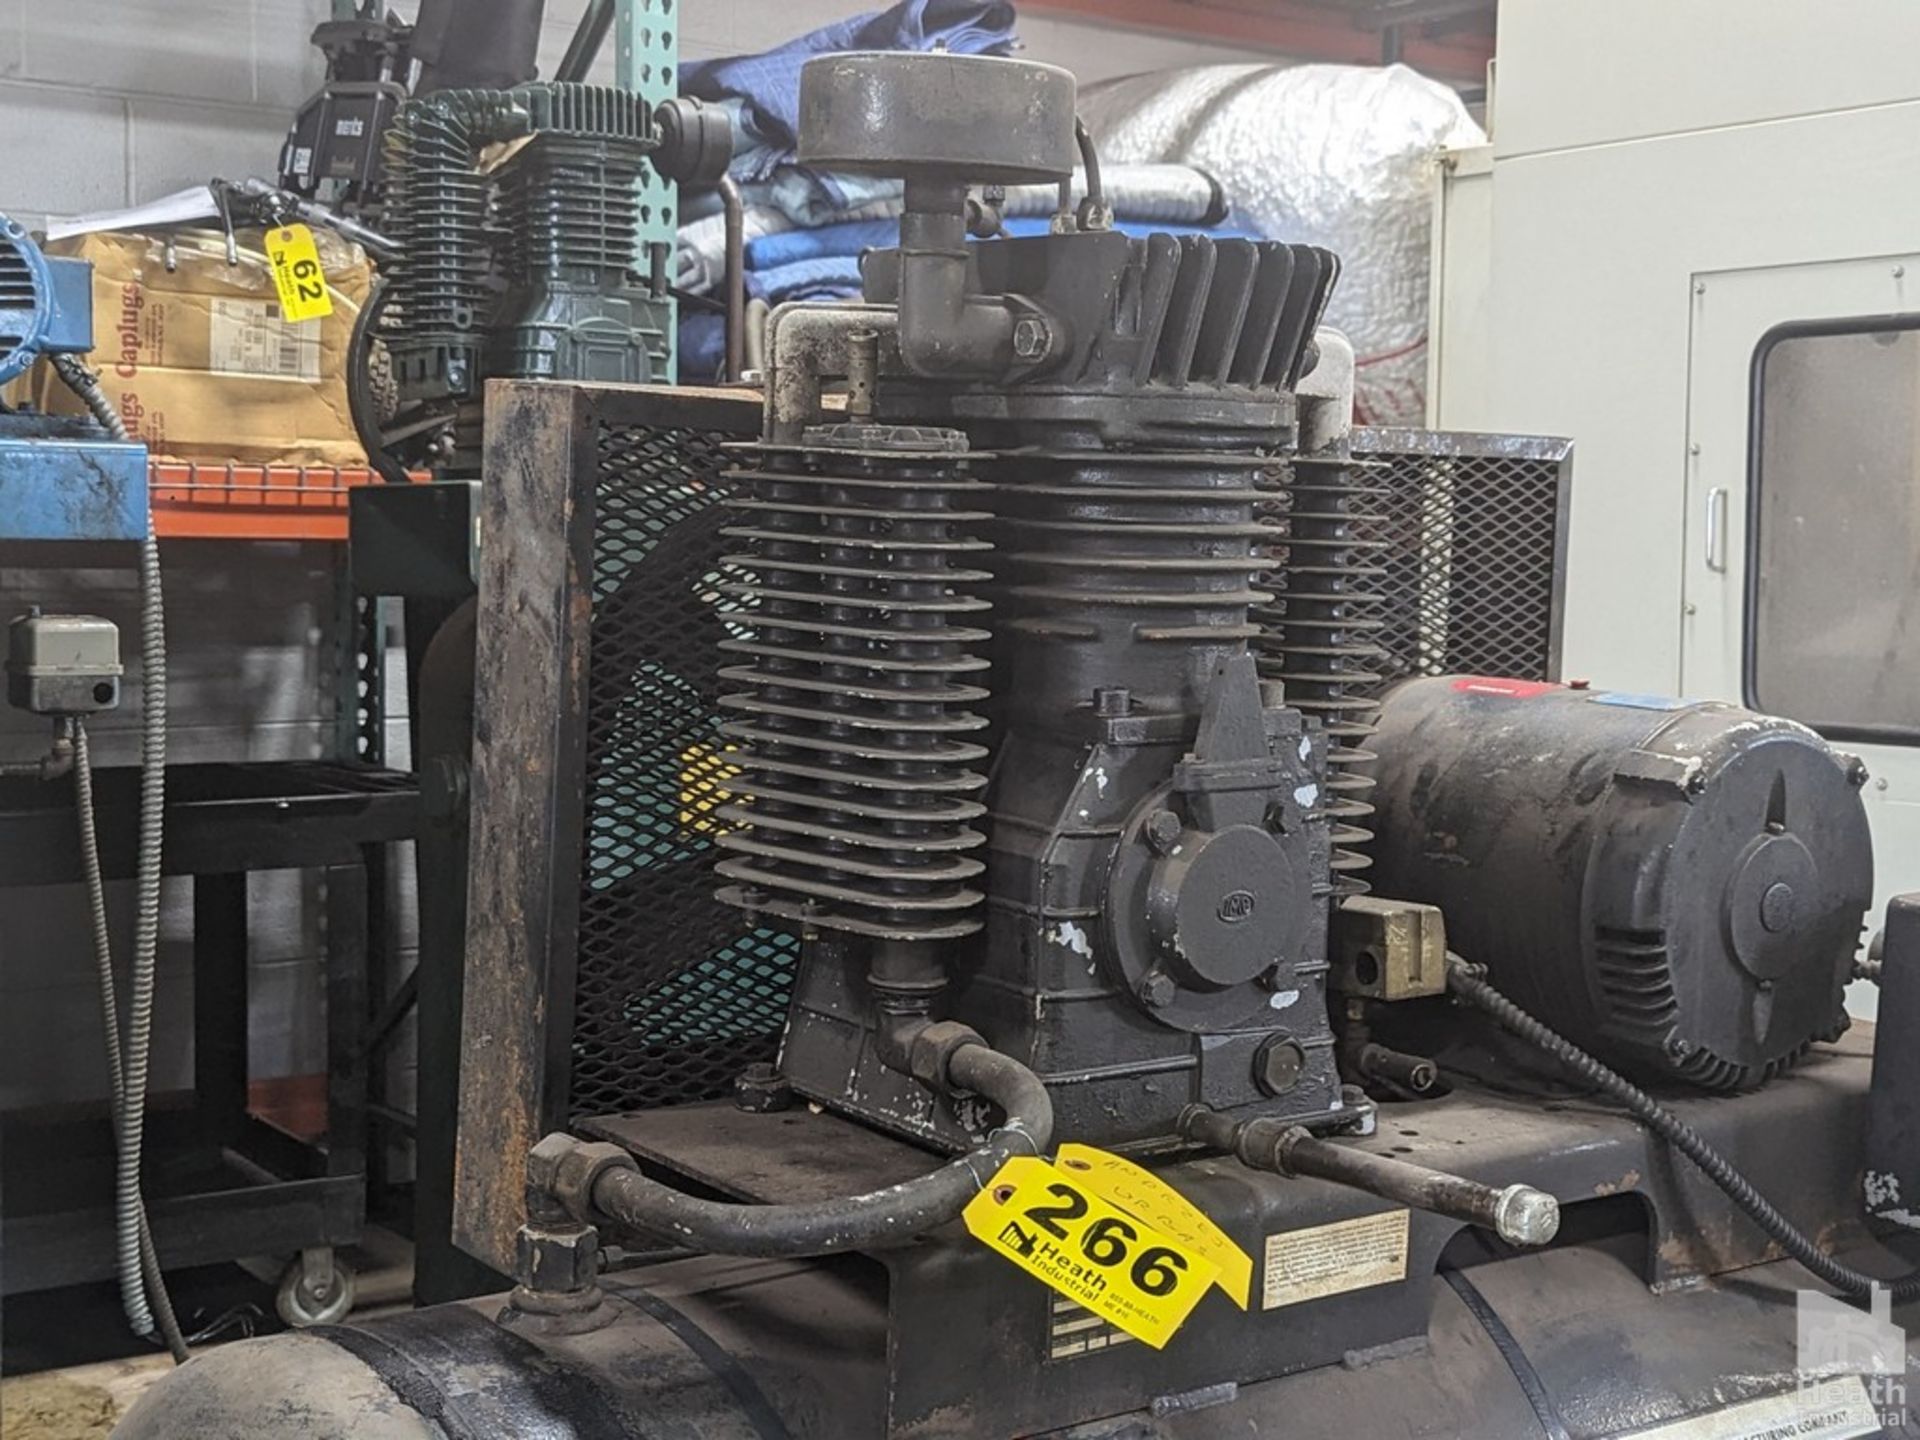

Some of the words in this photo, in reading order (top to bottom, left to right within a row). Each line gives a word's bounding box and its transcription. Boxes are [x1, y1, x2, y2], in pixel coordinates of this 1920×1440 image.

[293, 260, 322, 302] 62
[115, 282, 145, 379] Caplugs
[1023, 1183, 1188, 1297] 266
[1031, 1254, 1100, 1302] Industrial
[1040, 1242, 1108, 1291] Heath
